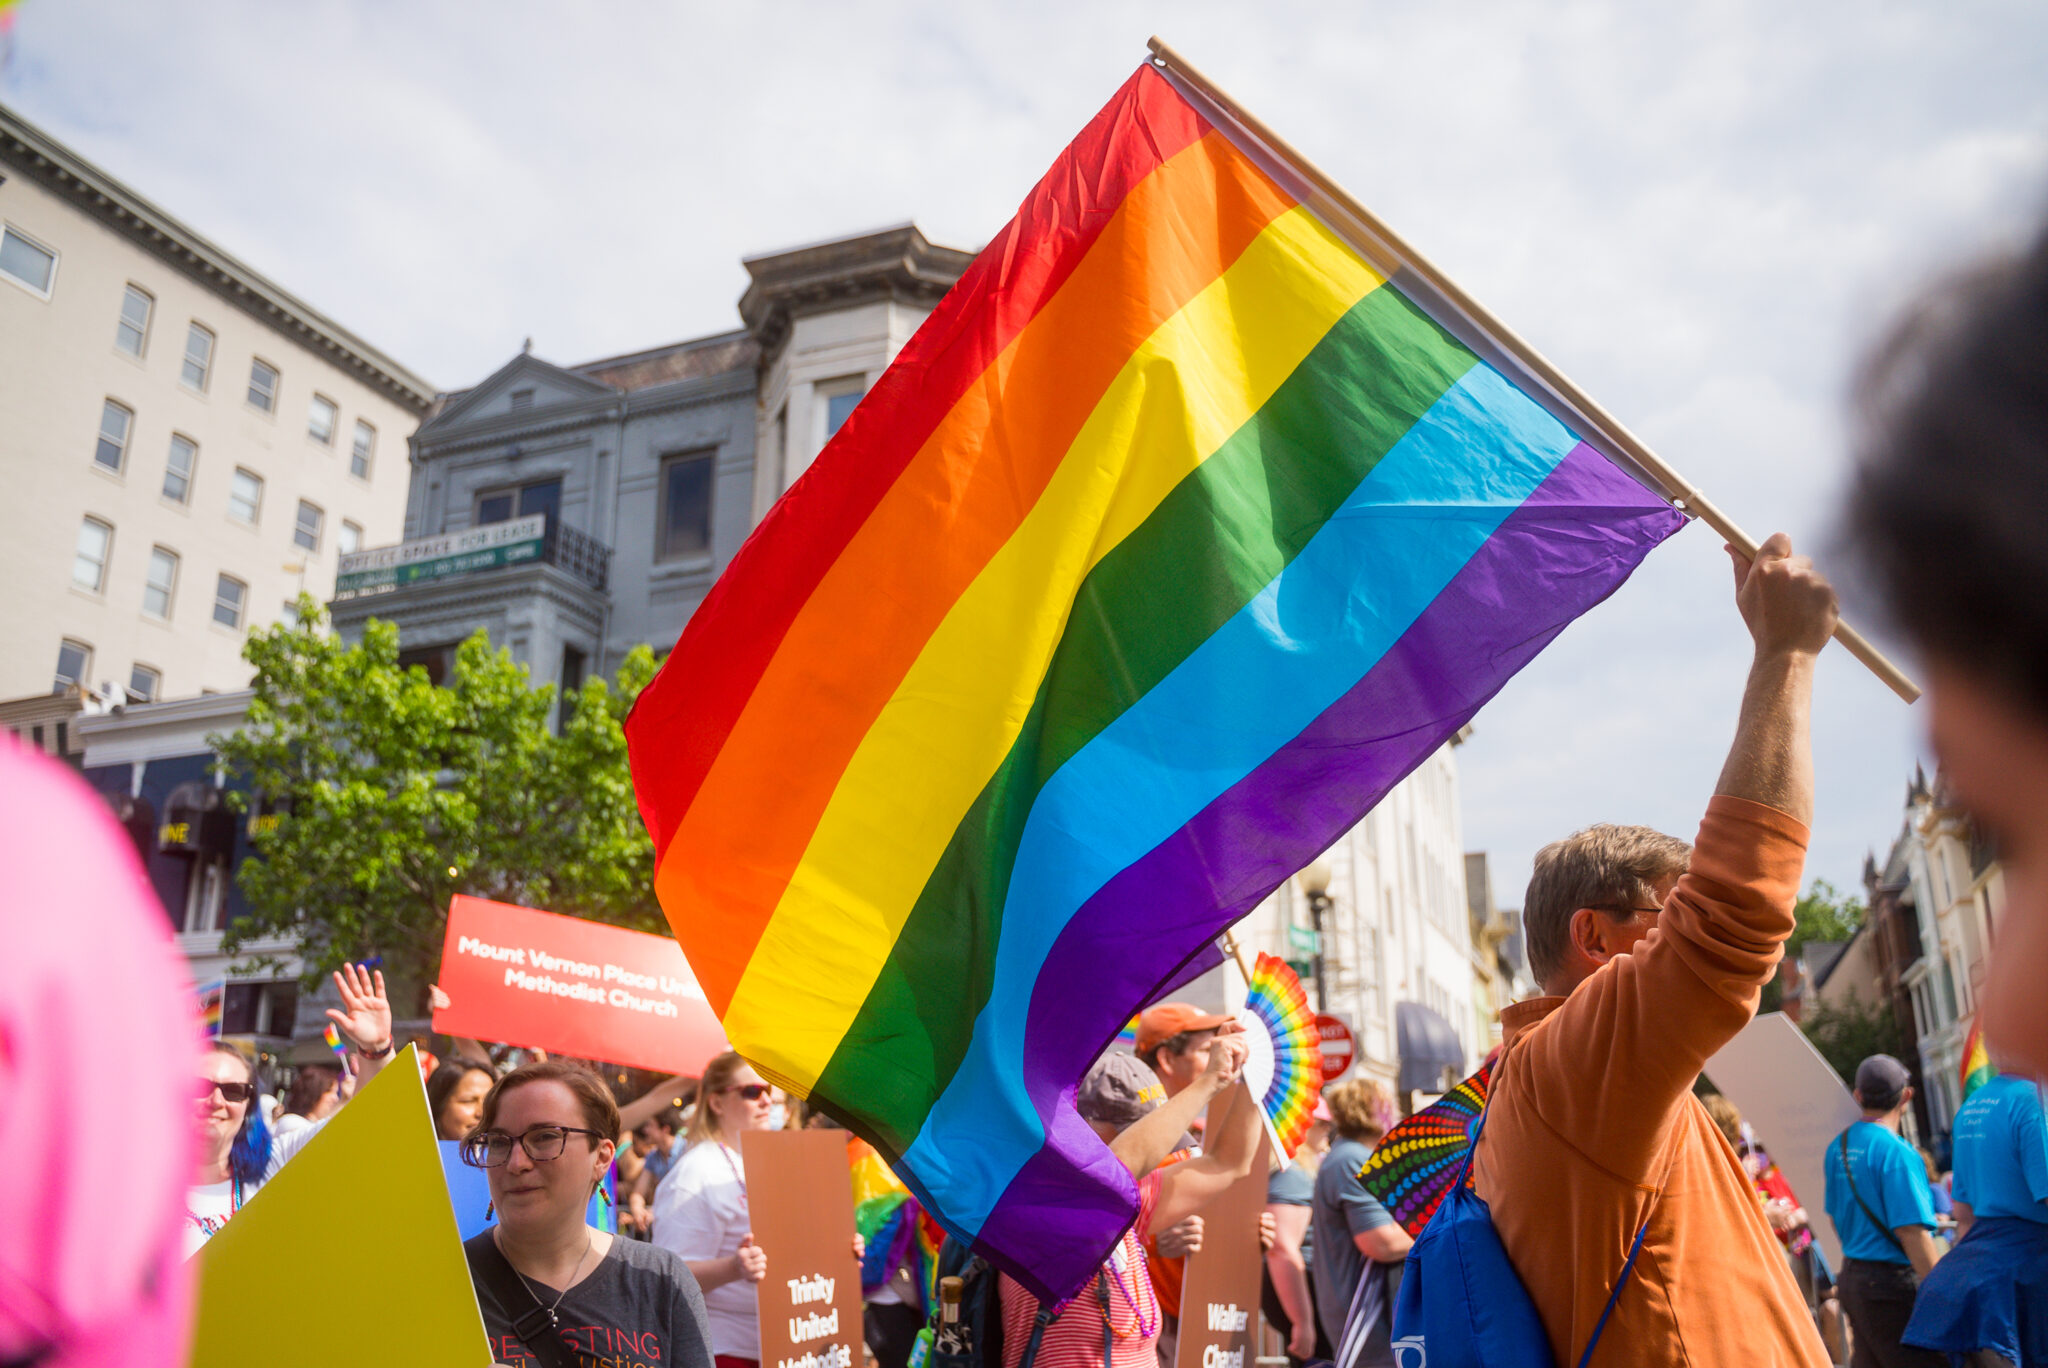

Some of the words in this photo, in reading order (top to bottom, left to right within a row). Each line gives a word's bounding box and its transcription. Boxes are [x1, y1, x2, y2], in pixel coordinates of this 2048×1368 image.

[458, 936, 526, 965] Mount
[528, 949, 601, 980] Vernon
[603, 964, 658, 991] Place
[660, 976, 709, 1001] Unit
[504, 968, 607, 1005] Methodist
[609, 988, 678, 1018] Church
[787, 1272, 836, 1305] Trinity
[789, 1307, 839, 1344] United
[1207, 1303, 1248, 1332] Walker
